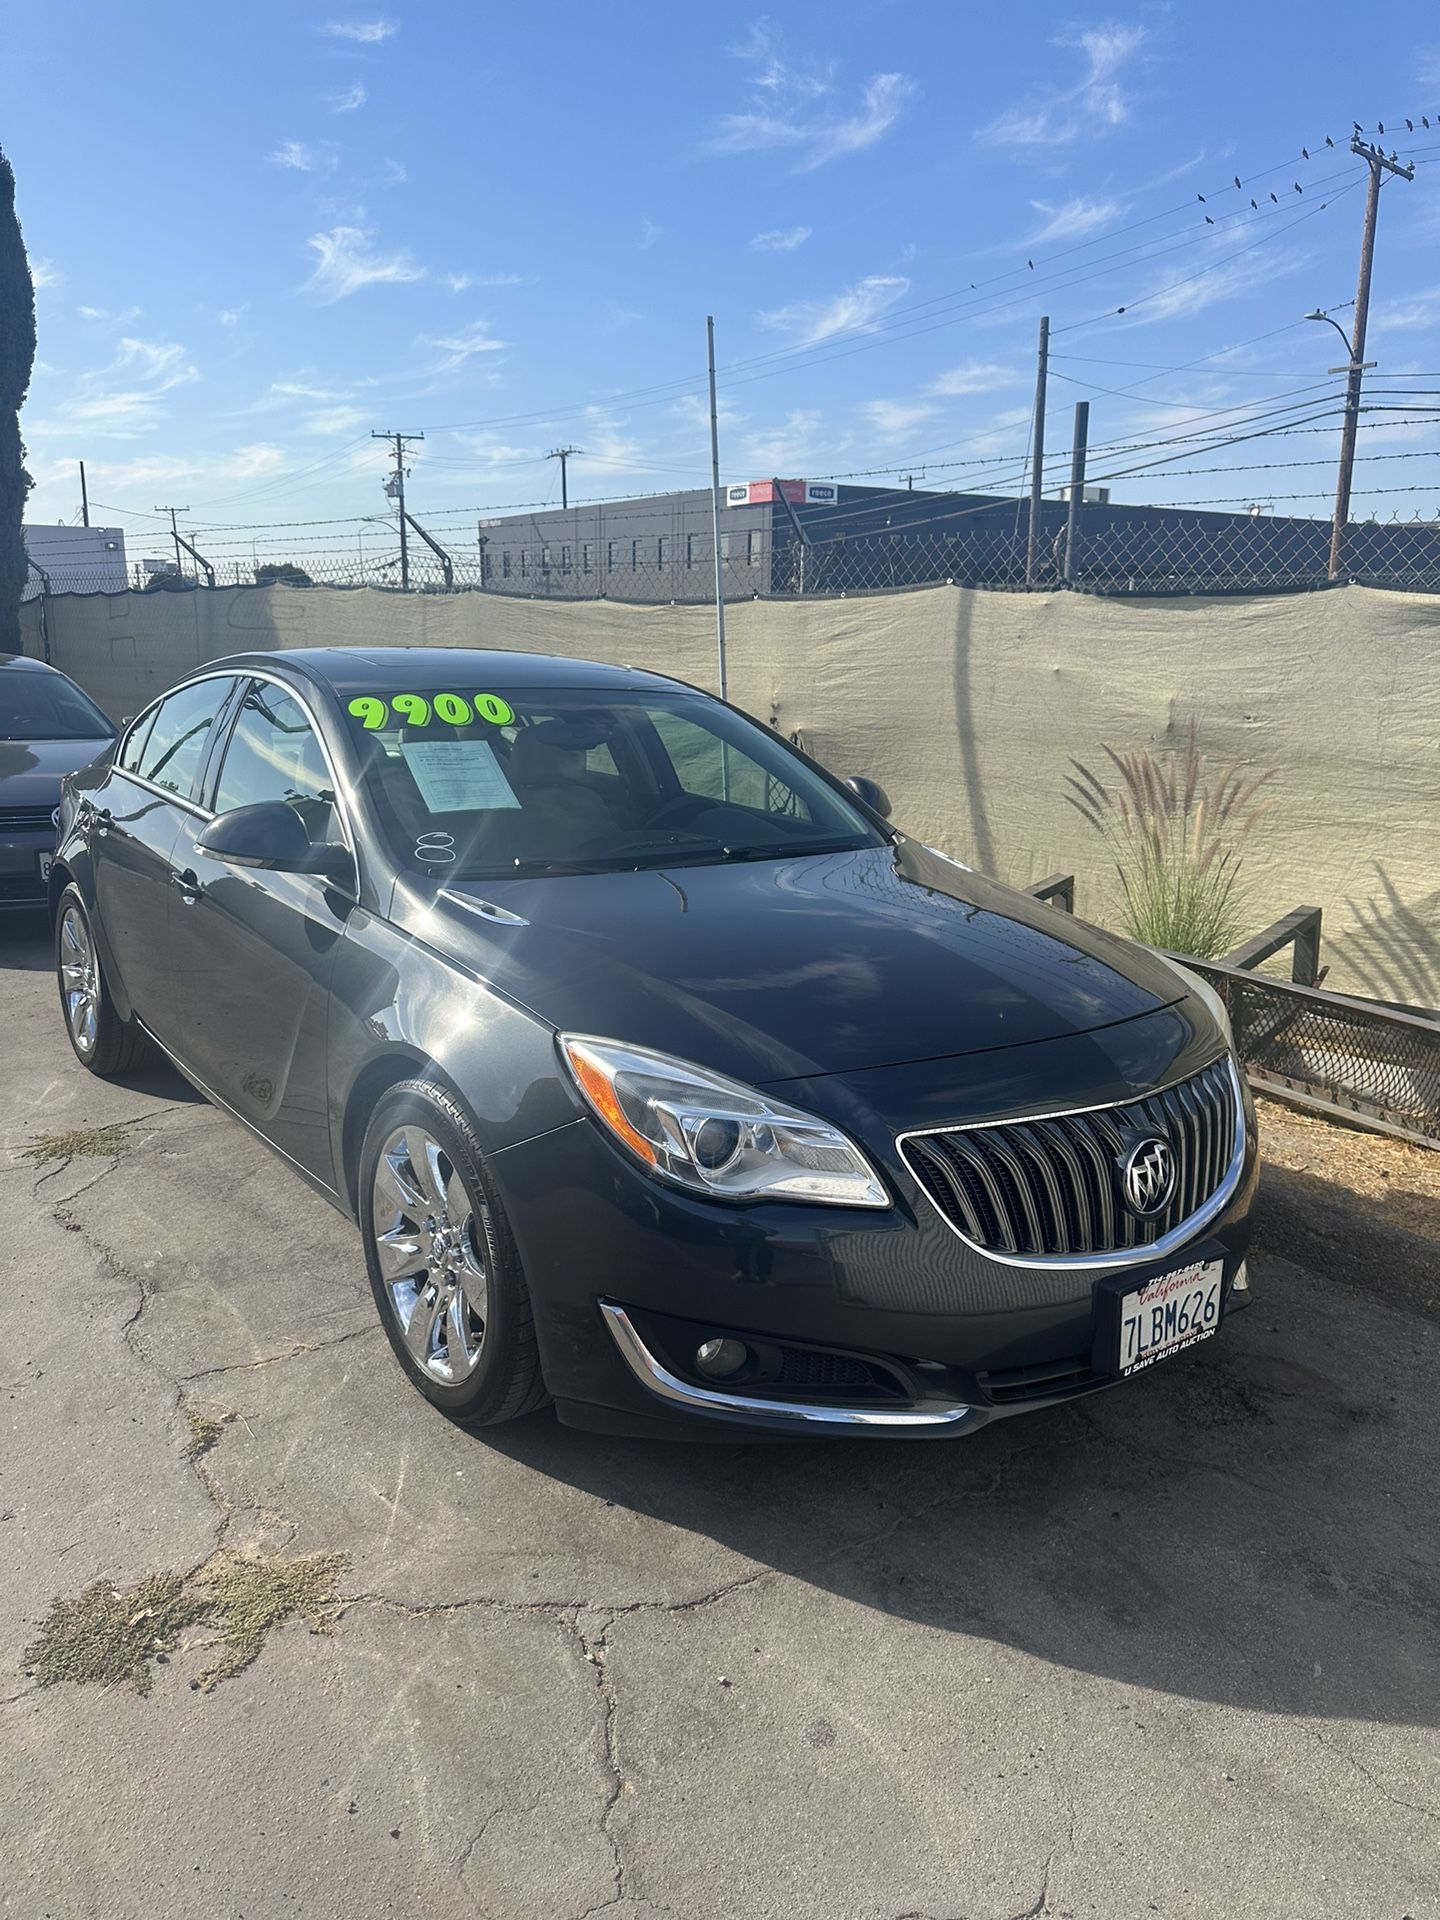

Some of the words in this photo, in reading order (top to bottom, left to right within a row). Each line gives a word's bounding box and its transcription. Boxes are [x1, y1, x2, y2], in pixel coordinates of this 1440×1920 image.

[811, 489, 832, 497] reece
[348, 692, 516, 730] 9900
[1139, 1271, 1206, 1306] California
[1123, 1283, 1218, 1359] 7LBM626
[1124, 1367, 1132, 1376] U
[1132, 1356, 1155, 1373] SAVE
[1155, 1344, 1179, 1361] AUTO
[1180, 1328, 1216, 1350] AUCTION
